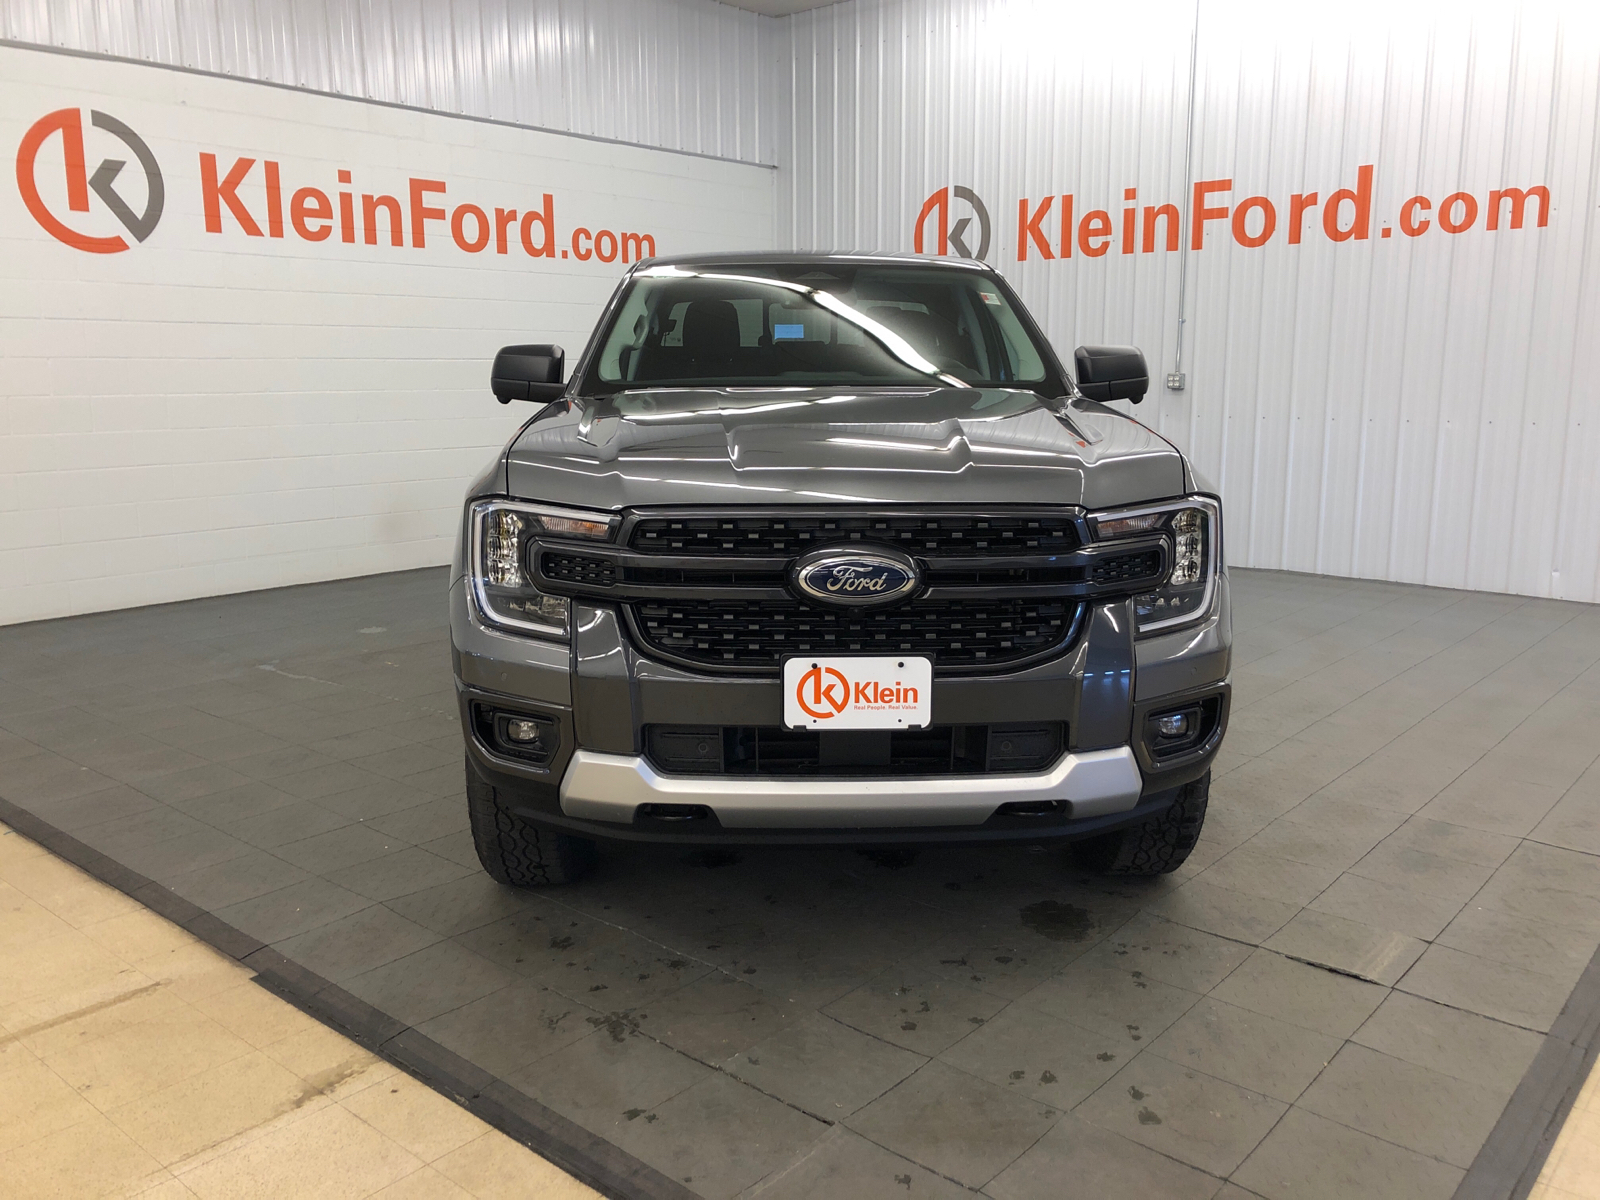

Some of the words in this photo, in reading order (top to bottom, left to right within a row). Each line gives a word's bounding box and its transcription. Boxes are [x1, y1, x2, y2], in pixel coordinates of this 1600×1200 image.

[199, 151, 657, 264] KleinFord.com
[1016, 164, 1551, 262] KleinFord.com
[826, 565, 889, 591] Ford
[854, 681, 919, 704] Klein
